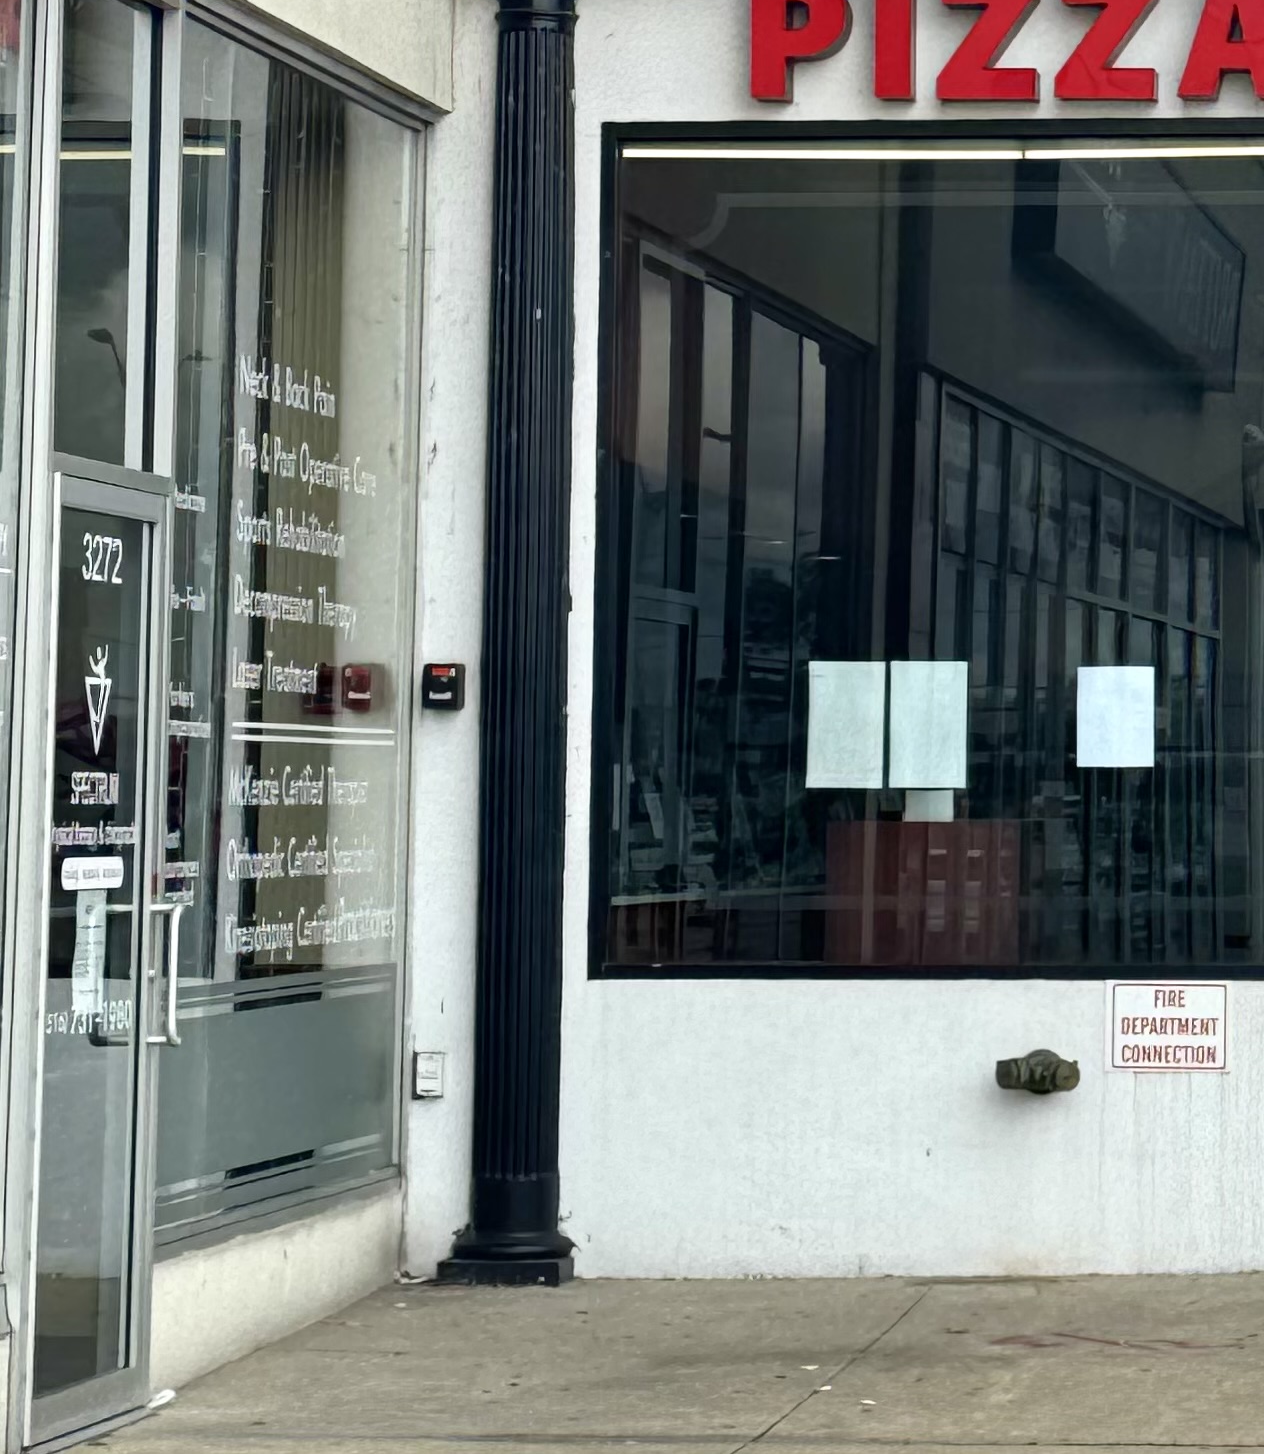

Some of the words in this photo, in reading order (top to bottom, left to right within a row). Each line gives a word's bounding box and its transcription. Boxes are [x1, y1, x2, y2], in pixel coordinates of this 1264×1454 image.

[285, 366, 310, 412] Back
[313, 375, 336, 419] Pain
[81, 531, 123, 585] 3272
[1154, 989, 1186, 1008] FIRE
[1121, 1017, 1219, 1037] DEPARTMENT
[1121, 1044, 1217, 1064] CONNECTION
